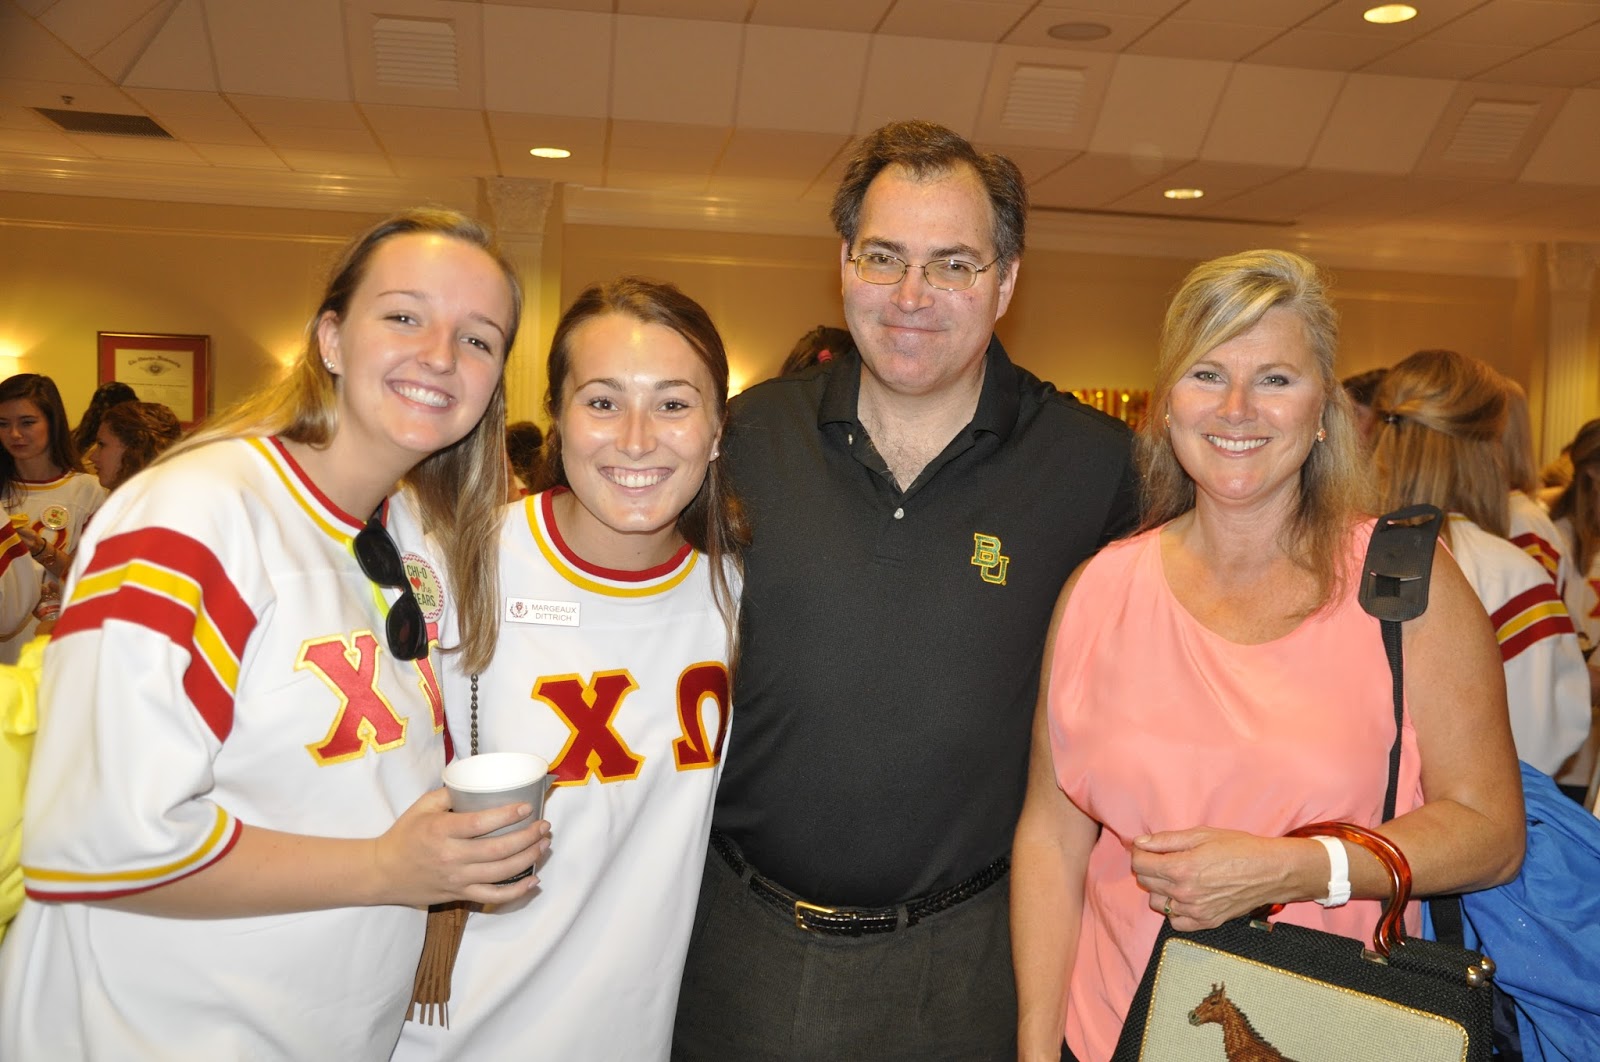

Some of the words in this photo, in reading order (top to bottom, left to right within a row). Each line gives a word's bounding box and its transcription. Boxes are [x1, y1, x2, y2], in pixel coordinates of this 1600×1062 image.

[971, 532, 1009, 584] BU
[407, 564, 427, 579] CHI-O
[531, 604, 577, 614] MARGEAUX
[535, 612, 572, 622] DITTRICH
